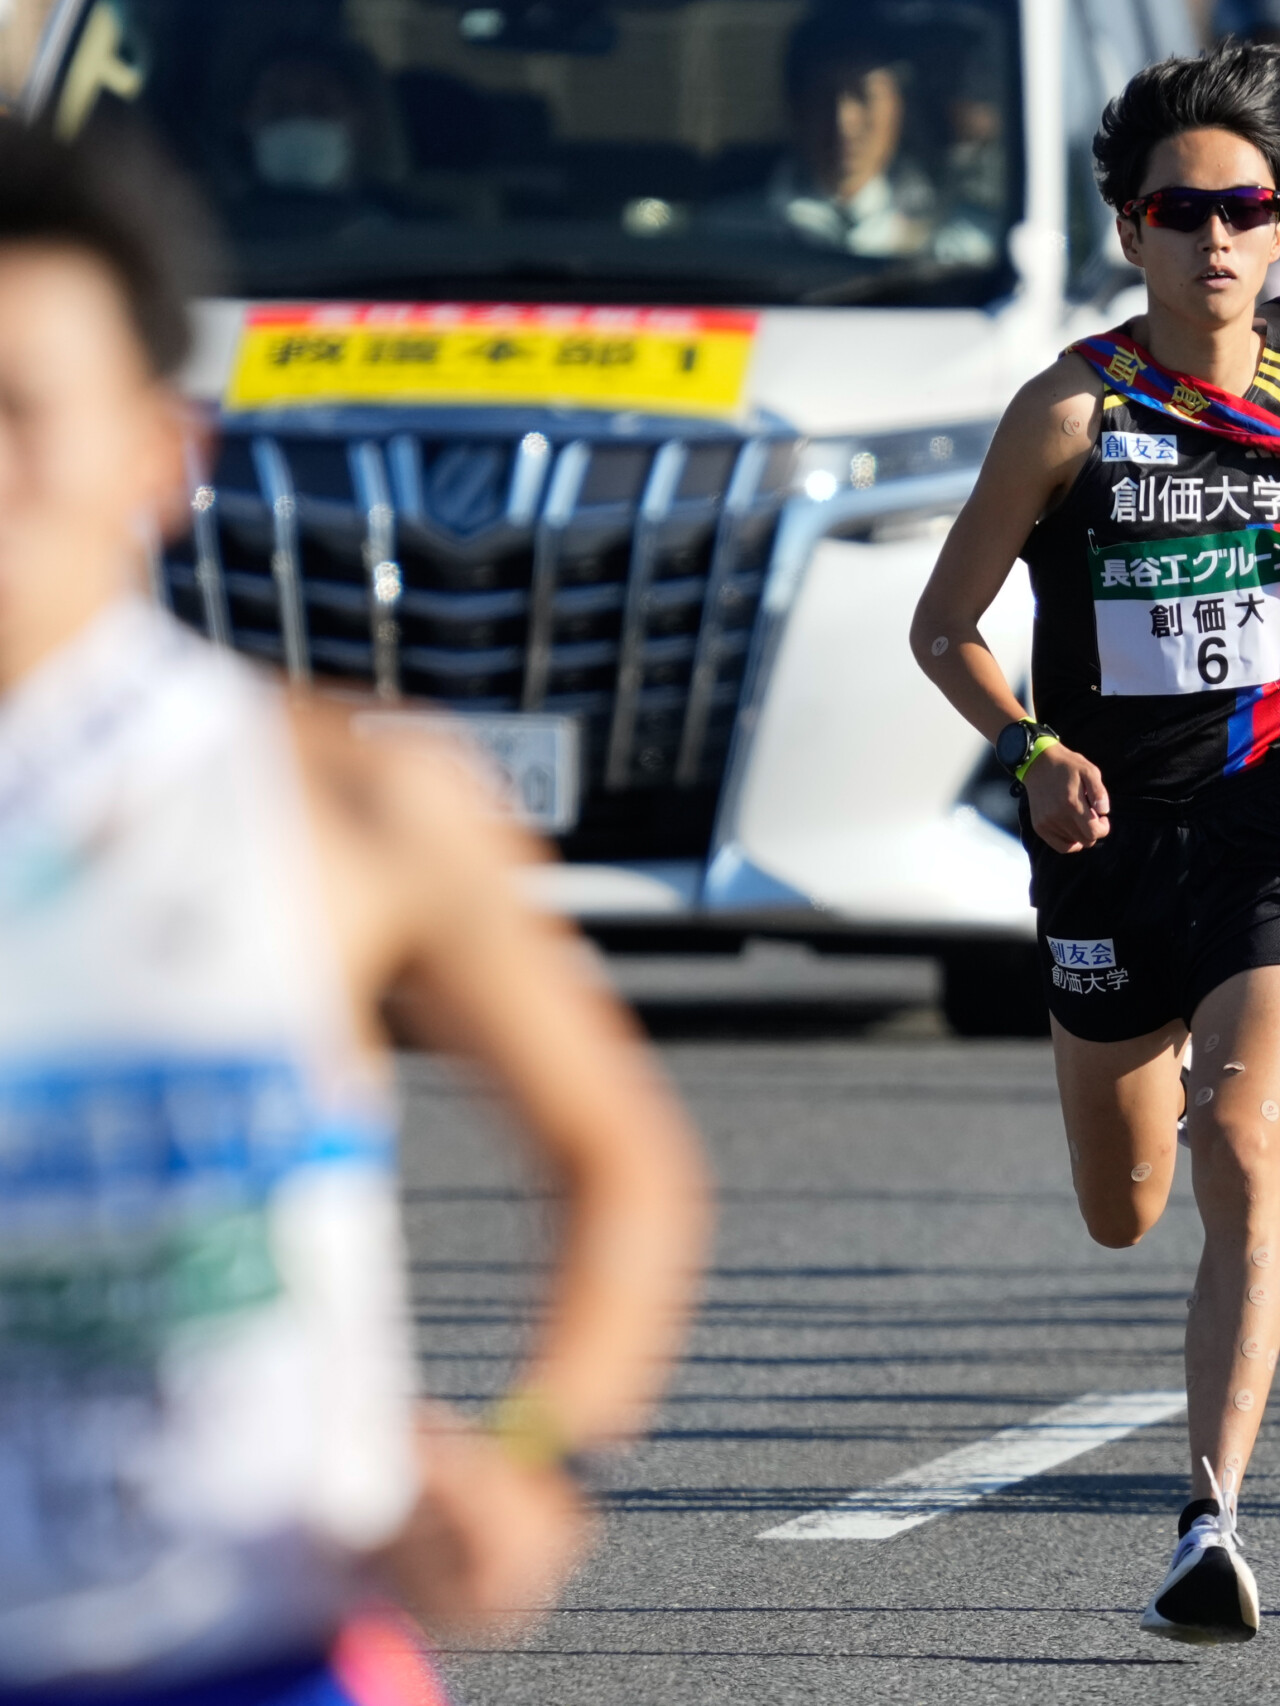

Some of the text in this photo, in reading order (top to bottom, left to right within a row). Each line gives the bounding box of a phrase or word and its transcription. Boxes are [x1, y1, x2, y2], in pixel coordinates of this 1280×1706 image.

[1104, 435, 1175, 460] 創友会
[1149, 593, 1265, 639] 創価大
[1197, 636, 1229, 686] 6
[1050, 940, 1113, 966] 創友会
[1051, 965, 1130, 995] 創価大学
